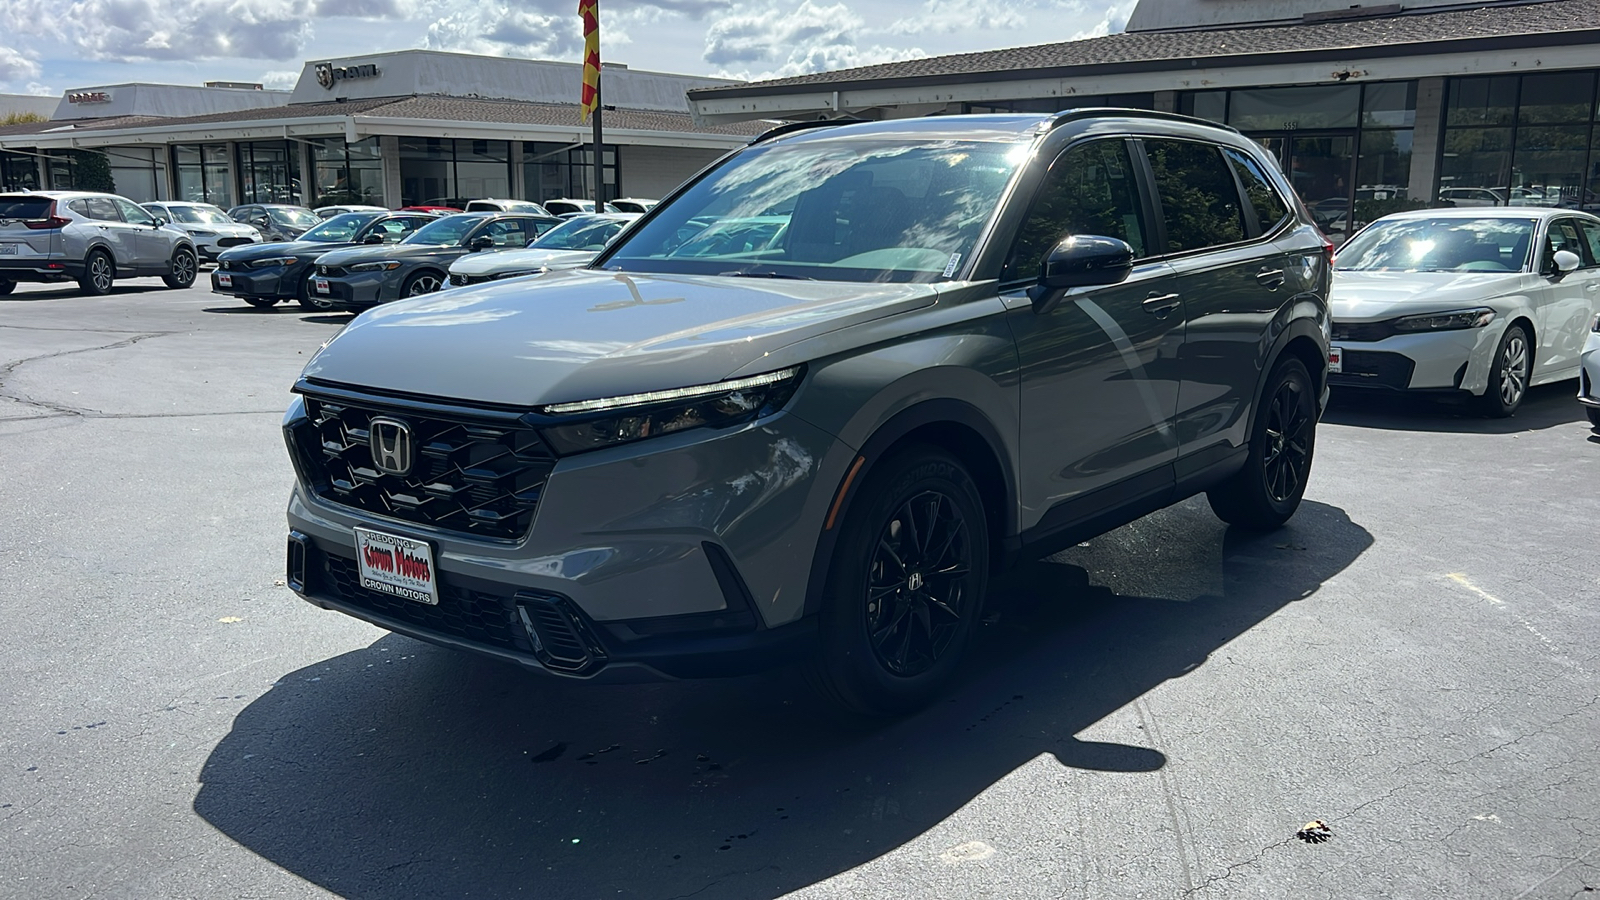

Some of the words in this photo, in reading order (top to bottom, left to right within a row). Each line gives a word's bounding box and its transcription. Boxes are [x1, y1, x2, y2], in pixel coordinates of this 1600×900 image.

[332, 64, 377, 80] RAM
[68, 92, 107, 103] DODGE
[371, 533, 409, 548] REDDING
[363, 545, 393, 573] Crown
[395, 545, 430, 582] Motors
[365, 579, 394, 593] CROWN
[395, 586, 430, 602] MOTORS
